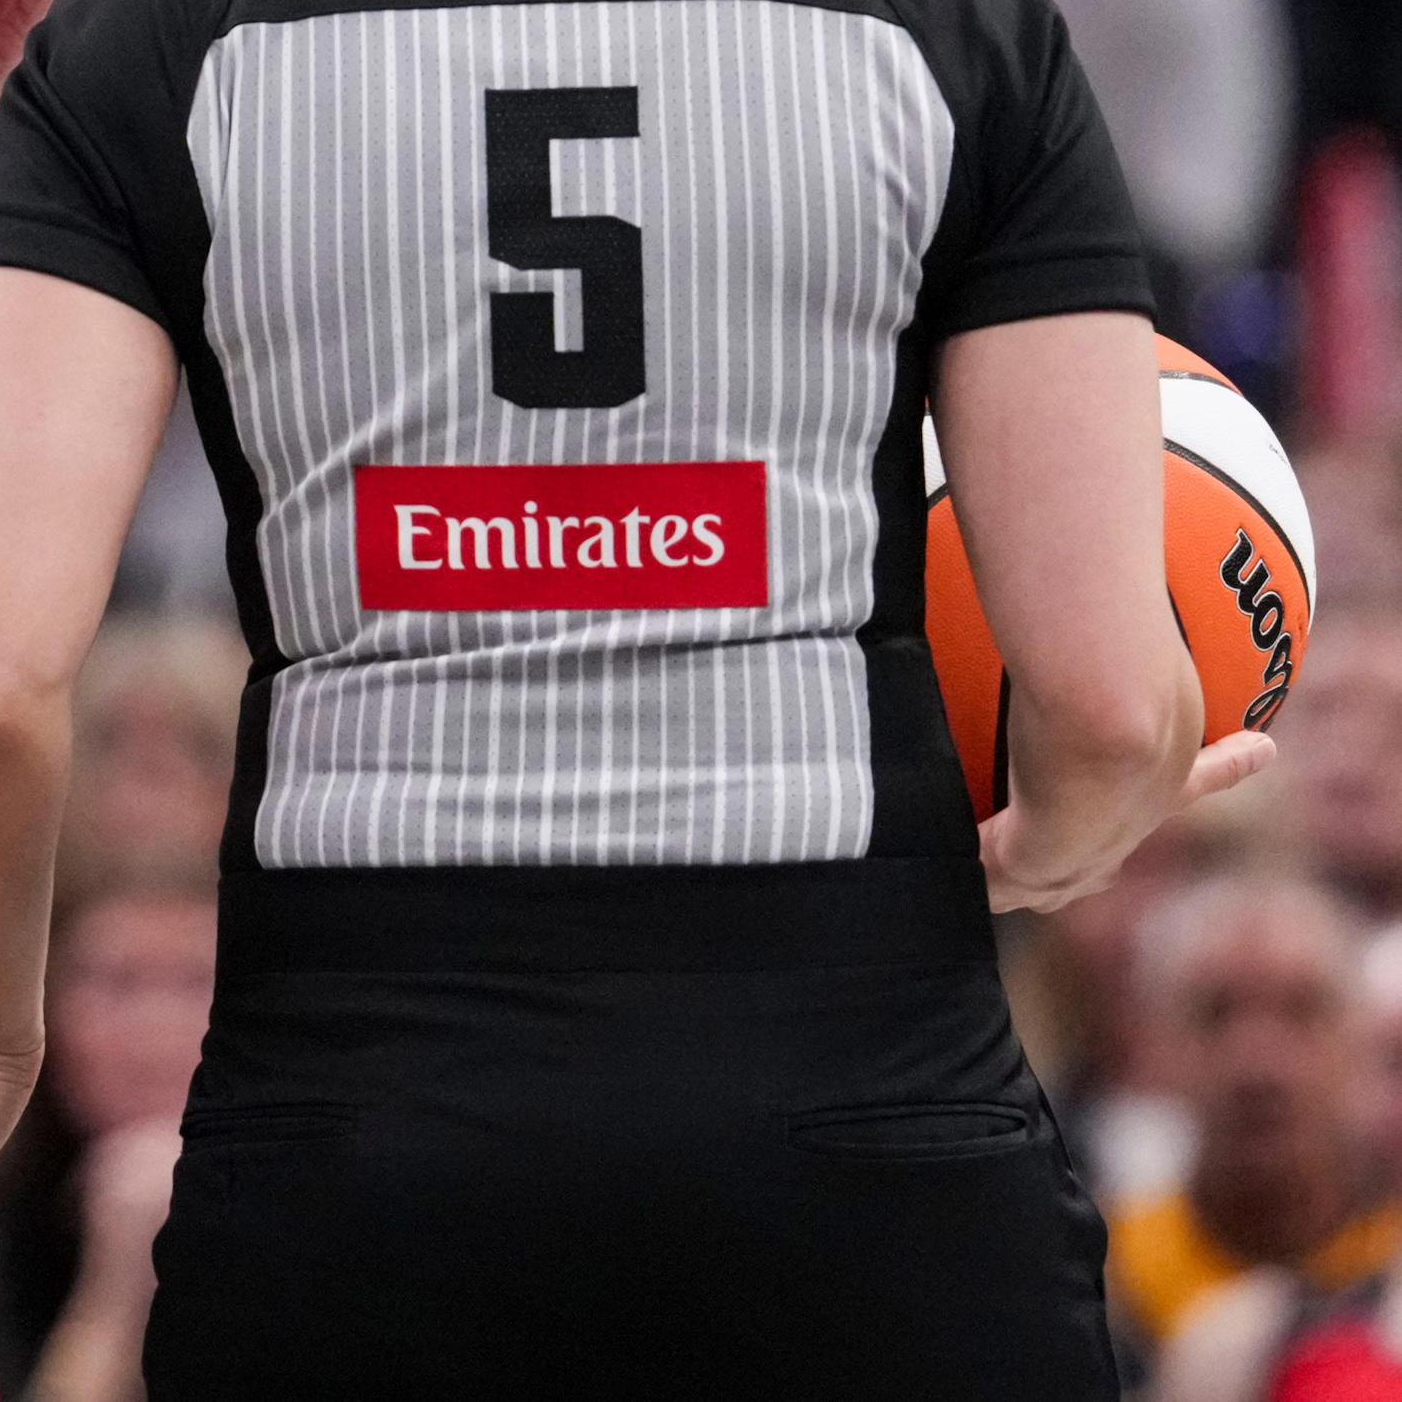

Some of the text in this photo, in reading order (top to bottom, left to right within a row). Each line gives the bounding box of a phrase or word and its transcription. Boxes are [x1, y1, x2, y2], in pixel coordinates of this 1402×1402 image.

[485, 86, 645, 409] 5
[393, 500, 726, 569] Emirates
[1219, 528, 1293, 733] lson
